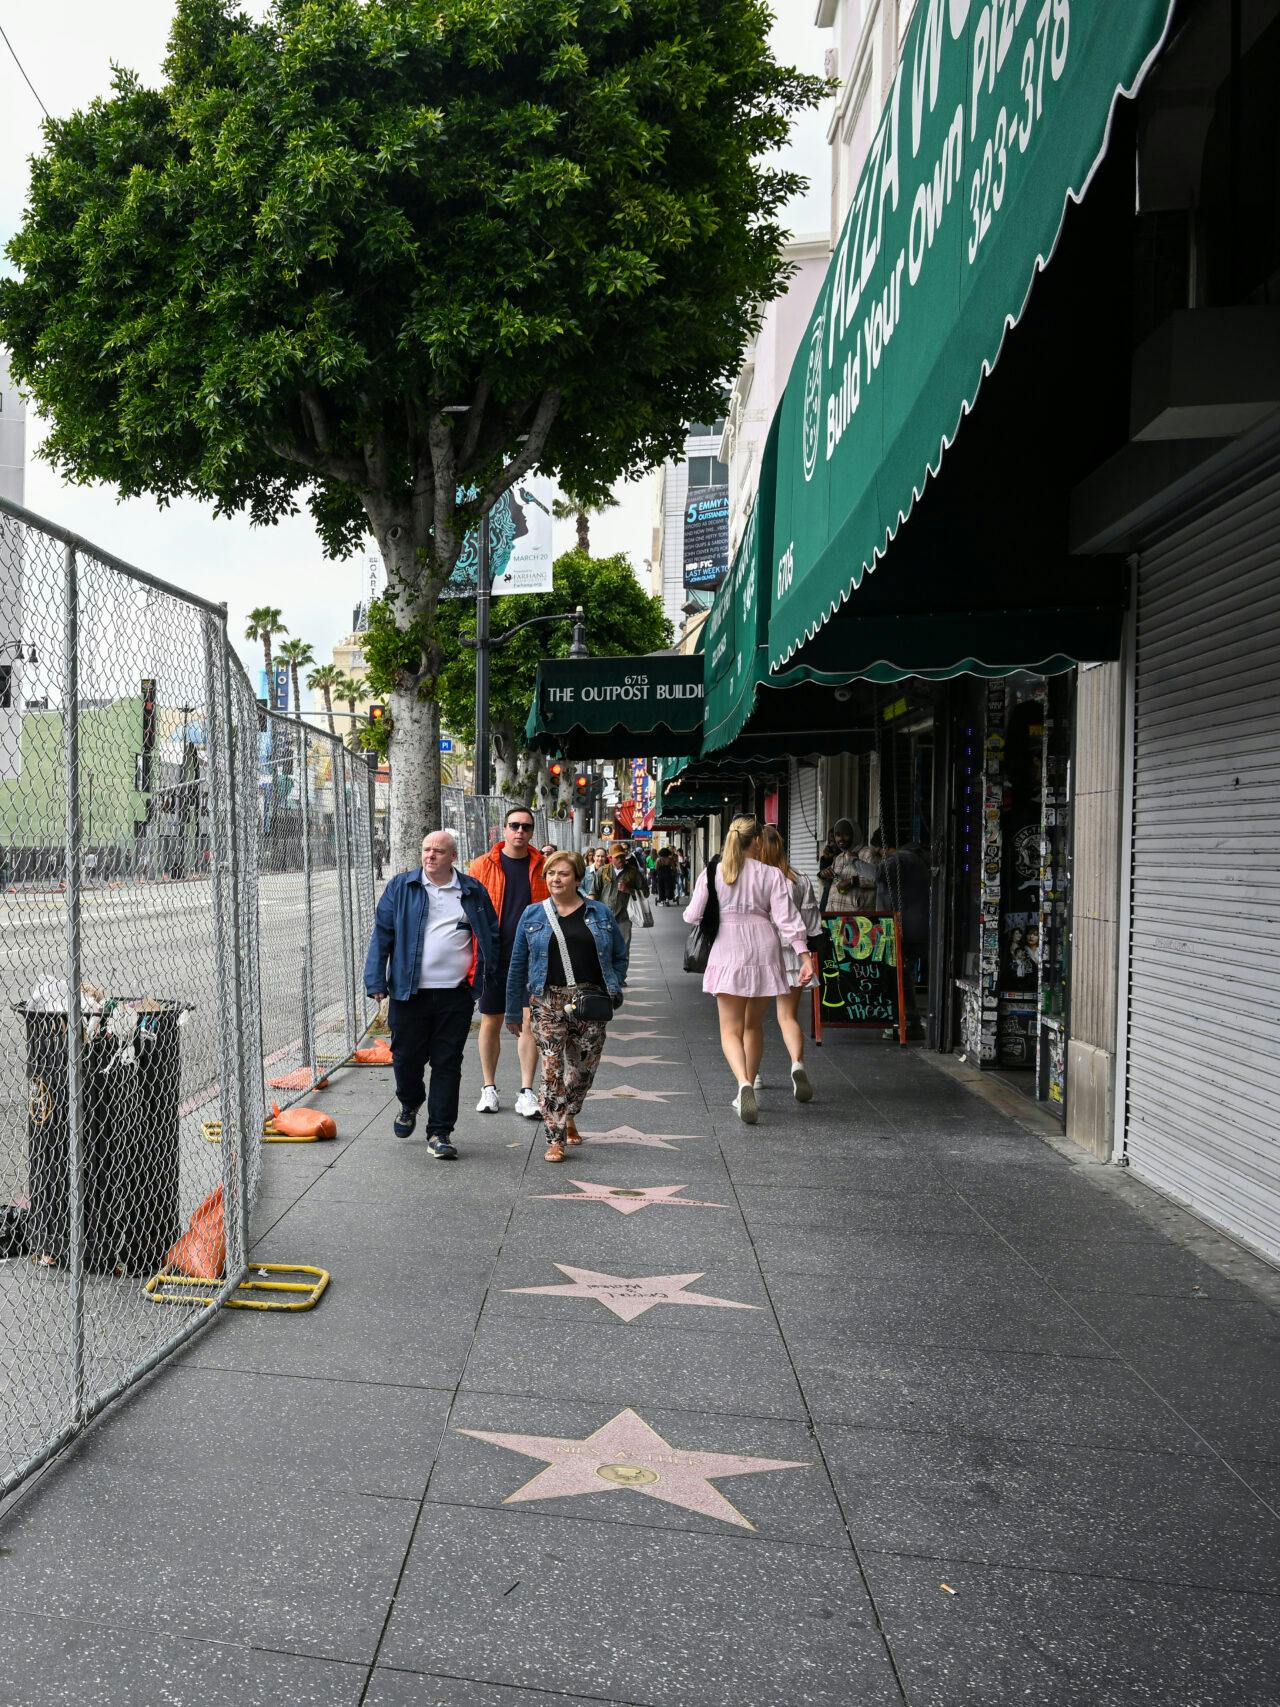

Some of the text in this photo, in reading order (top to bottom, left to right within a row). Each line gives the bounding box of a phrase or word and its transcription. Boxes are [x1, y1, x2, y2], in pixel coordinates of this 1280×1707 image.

[826, 330, 860, 460] Build
[864, 248, 904, 384] Your
[909, 104, 963, 286] Own
[687, 503, 698, 523] 5
[513, 554, 538, 562] MARCH
[700, 560, 713, 568] FYC
[685, 568, 699, 578] LAST
[703, 566, 720, 575] WEEK
[624, 675, 649, 685] 6715
[548, 683, 704, 702] THE OUTPOST BUILDI
[634, 768, 645, 818] MUSEUM
[853, 963, 880, 979] BUY
